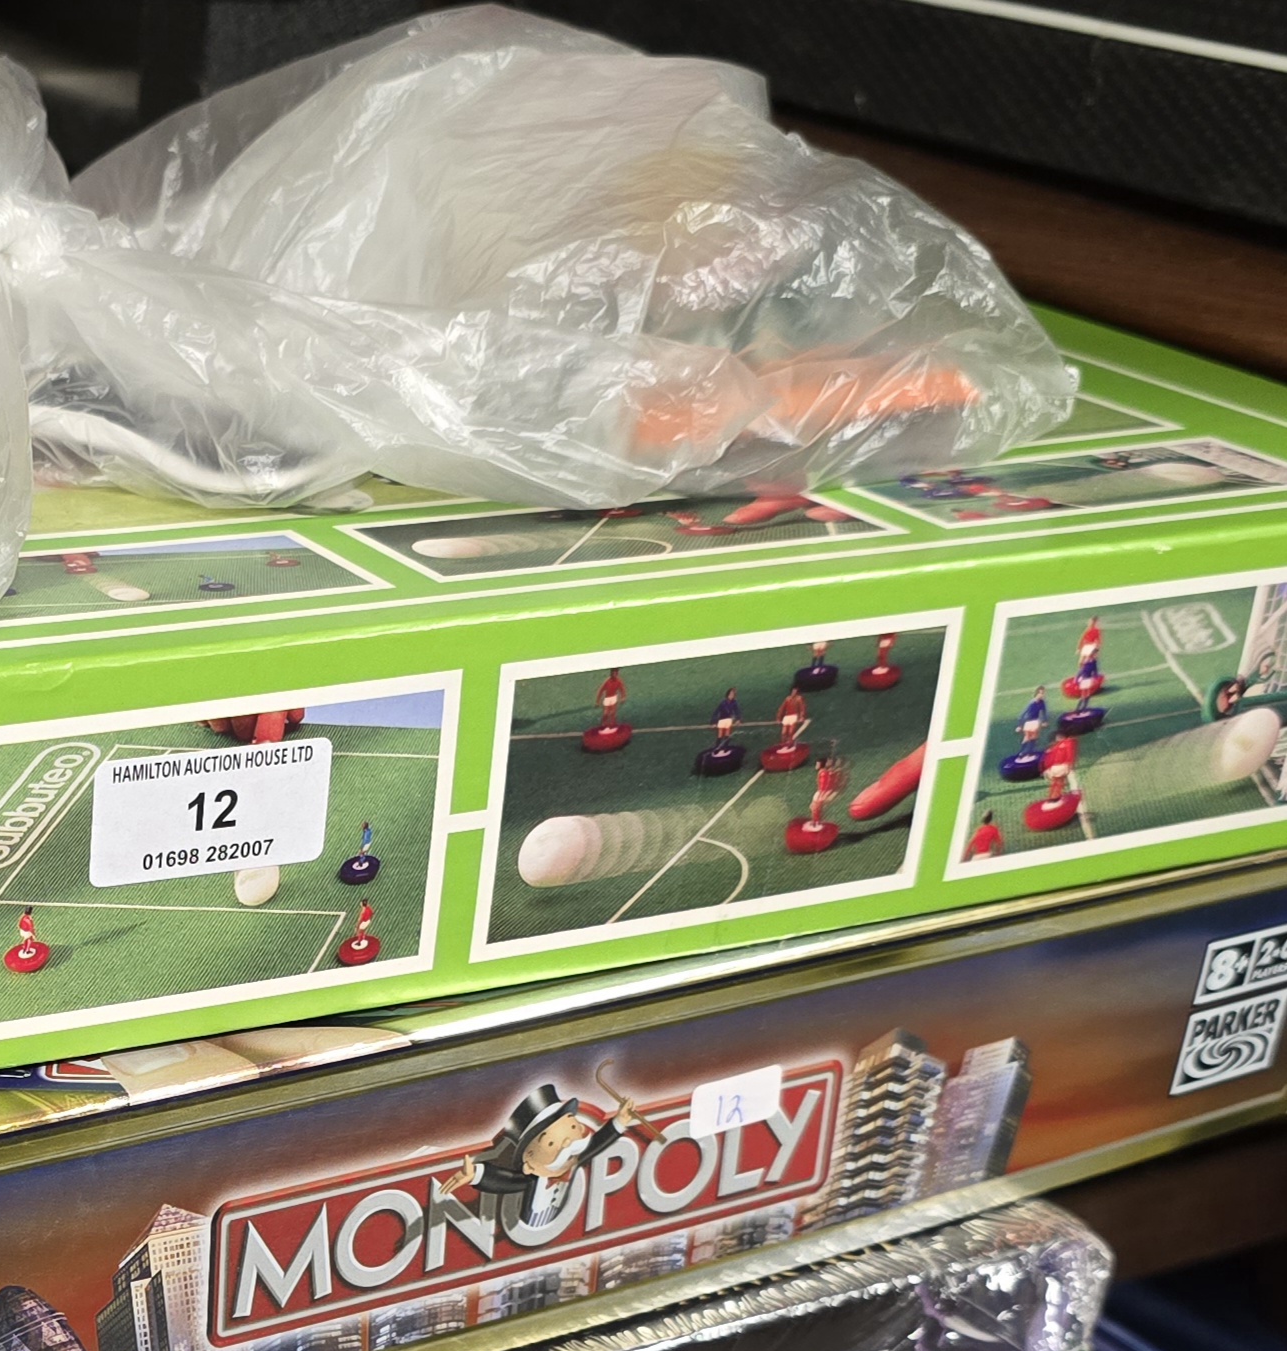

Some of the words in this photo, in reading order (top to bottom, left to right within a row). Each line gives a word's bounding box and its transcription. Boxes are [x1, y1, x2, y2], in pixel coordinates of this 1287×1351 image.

[112, 760, 181, 785] HAMILTON
[184, 755, 242, 777] AUCTION
[245, 749, 288, 770] HOUSE
[292, 745, 314, 764] LTD
[188, 789, 239, 832] 12
[142, 847, 200, 871] 01698
[205, 838, 275, 864] 282007
[1206, 948, 1250, 991] 8+
[1193, 998, 1281, 1042] PARKER
[716, 1094, 743, 1127] 12
[228, 1088, 823, 1322] MONOPOLY
